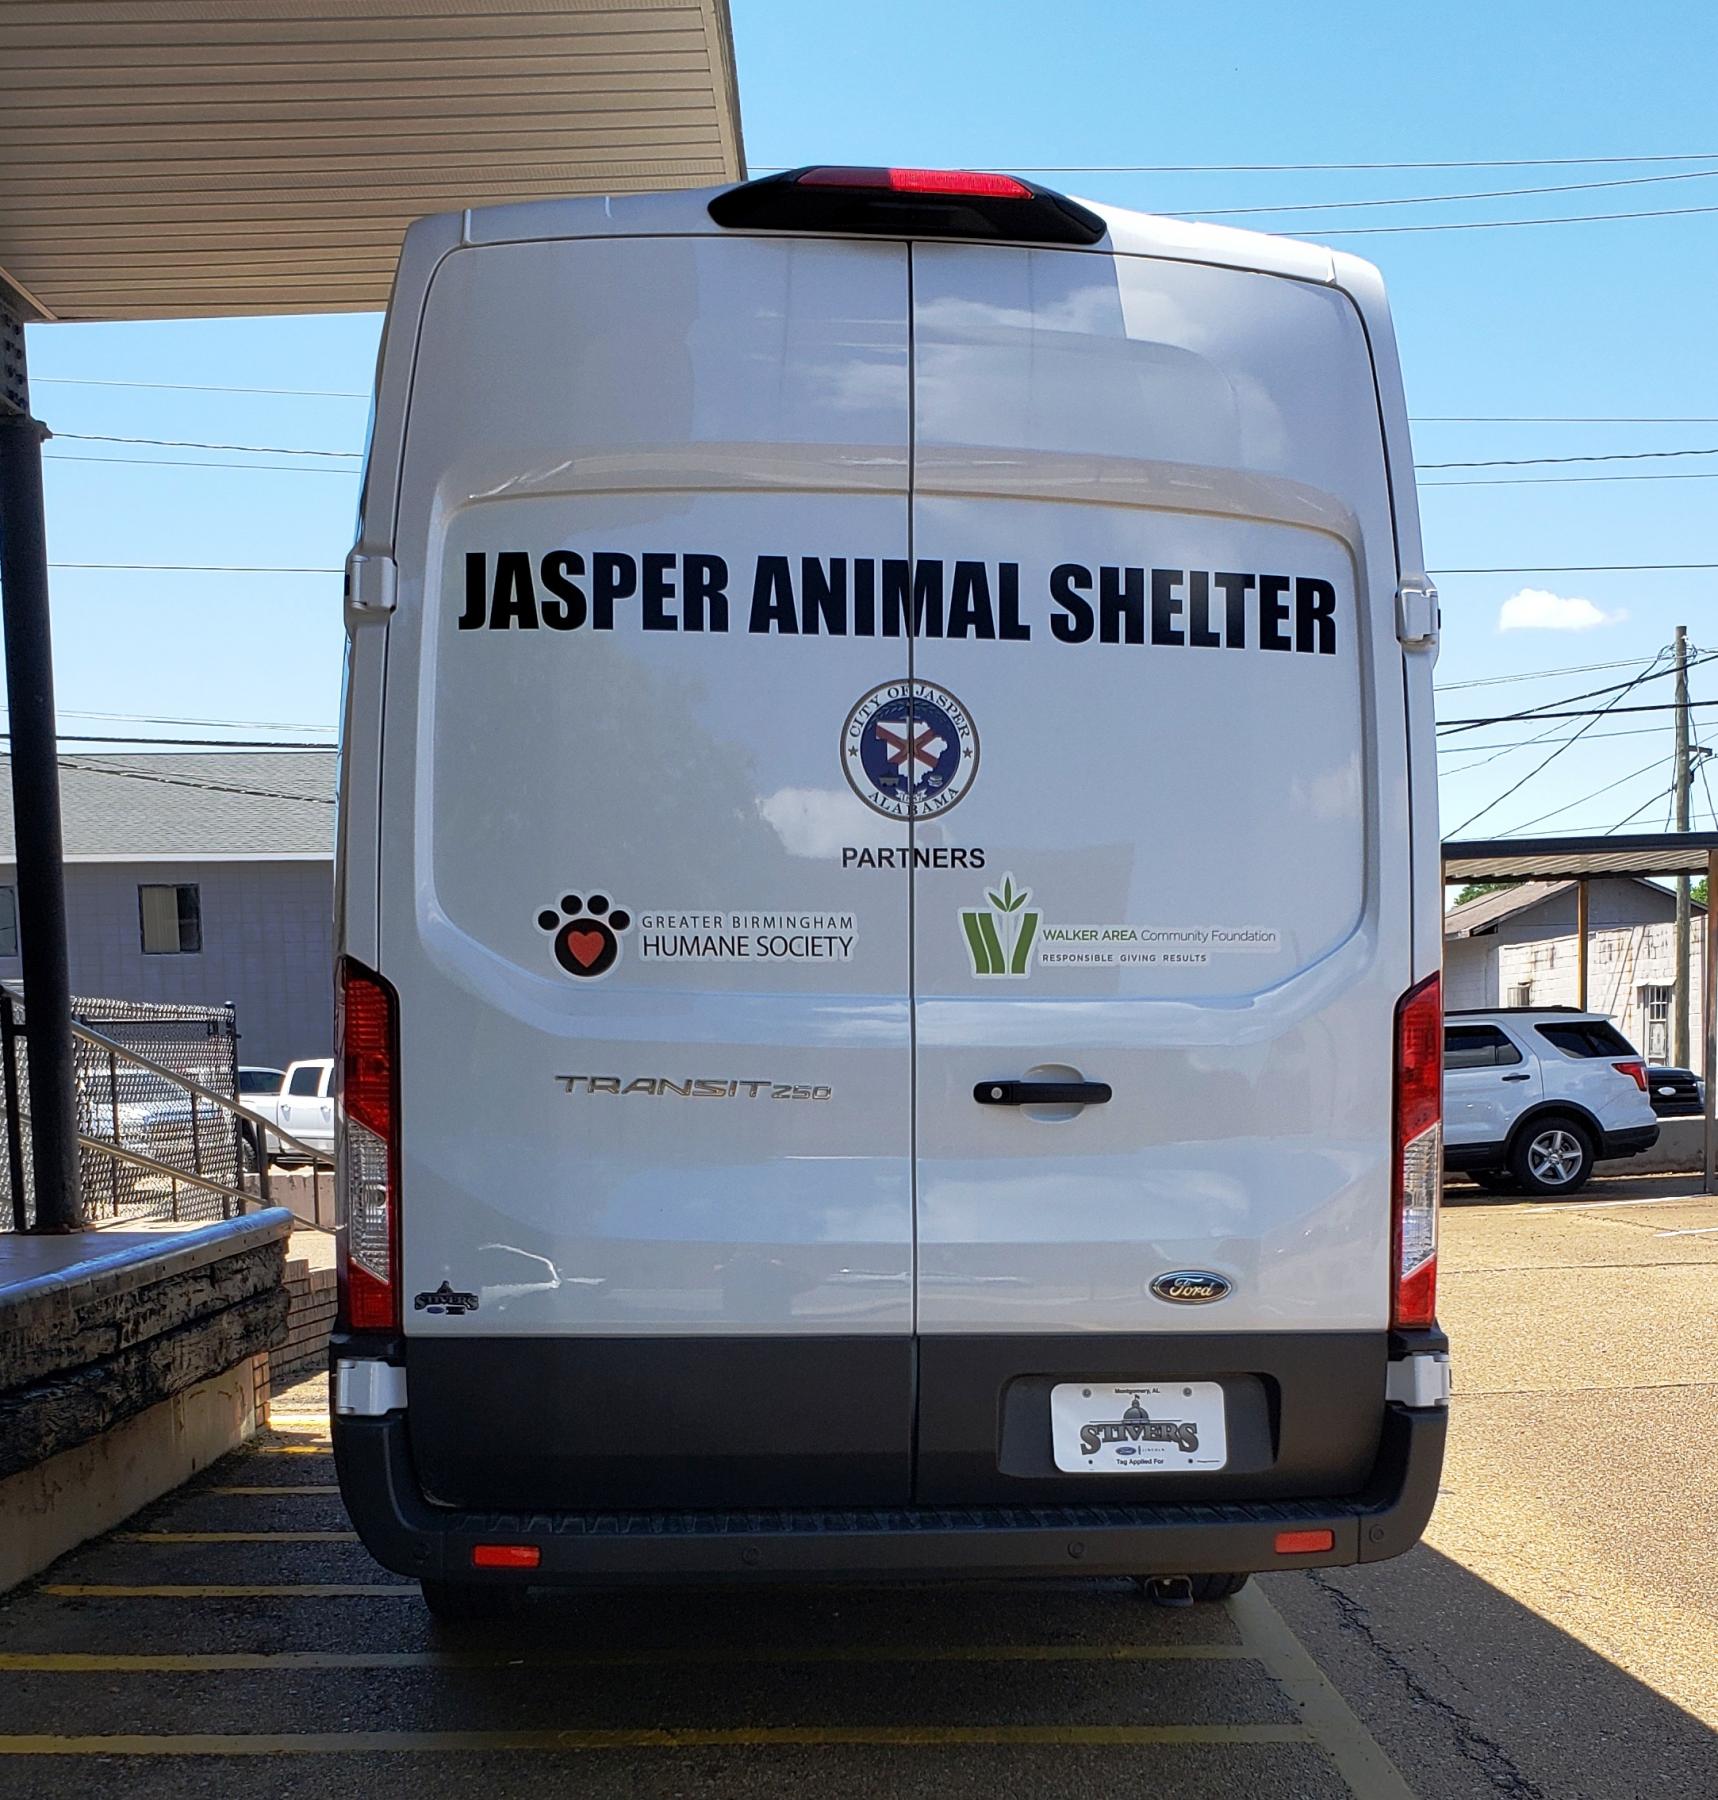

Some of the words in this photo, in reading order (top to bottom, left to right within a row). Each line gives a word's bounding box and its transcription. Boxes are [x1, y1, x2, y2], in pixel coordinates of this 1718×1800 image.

[458, 550, 729, 633] JASPER
[748, 555, 1031, 641] ANIMAL
[1050, 563, 1336, 655] SHELTER
[850, 696, 882, 738] CITY
[887, 685, 910, 699] OF
[915, 686, 971, 740] JASPER
[868, 787, 960, 816] ALABAMA
[842, 847, 985, 869] PARTNERS
[641, 915, 724, 929] GREATER
[732, 916, 853, 930] BIRMINGHAM
[643, 935, 750, 957] HUMANE
[756, 935, 854, 958] SOCIETY
[1043, 929, 1098, 942] WALKER
[1101, 930, 1138, 942] AREA
[1140, 929, 1209, 944] Community
[1211, 929, 1277, 943] Foundation
[1042, 953, 1113, 963] RESPONSIBLE
[1120, 953, 1157, 963] GIVING
[1163, 953, 1207, 963] RESULTS
[555, 1074, 772, 1098] TRANSIT
[771, 1084, 832, 1101] 250
[1168, 1276, 1216, 1297] Ford
[1080, 1422, 1200, 1456] STIVERS
[1116, 1458, 1128, 1466] Tag
[1129, 1458, 1153, 1466] Applied
